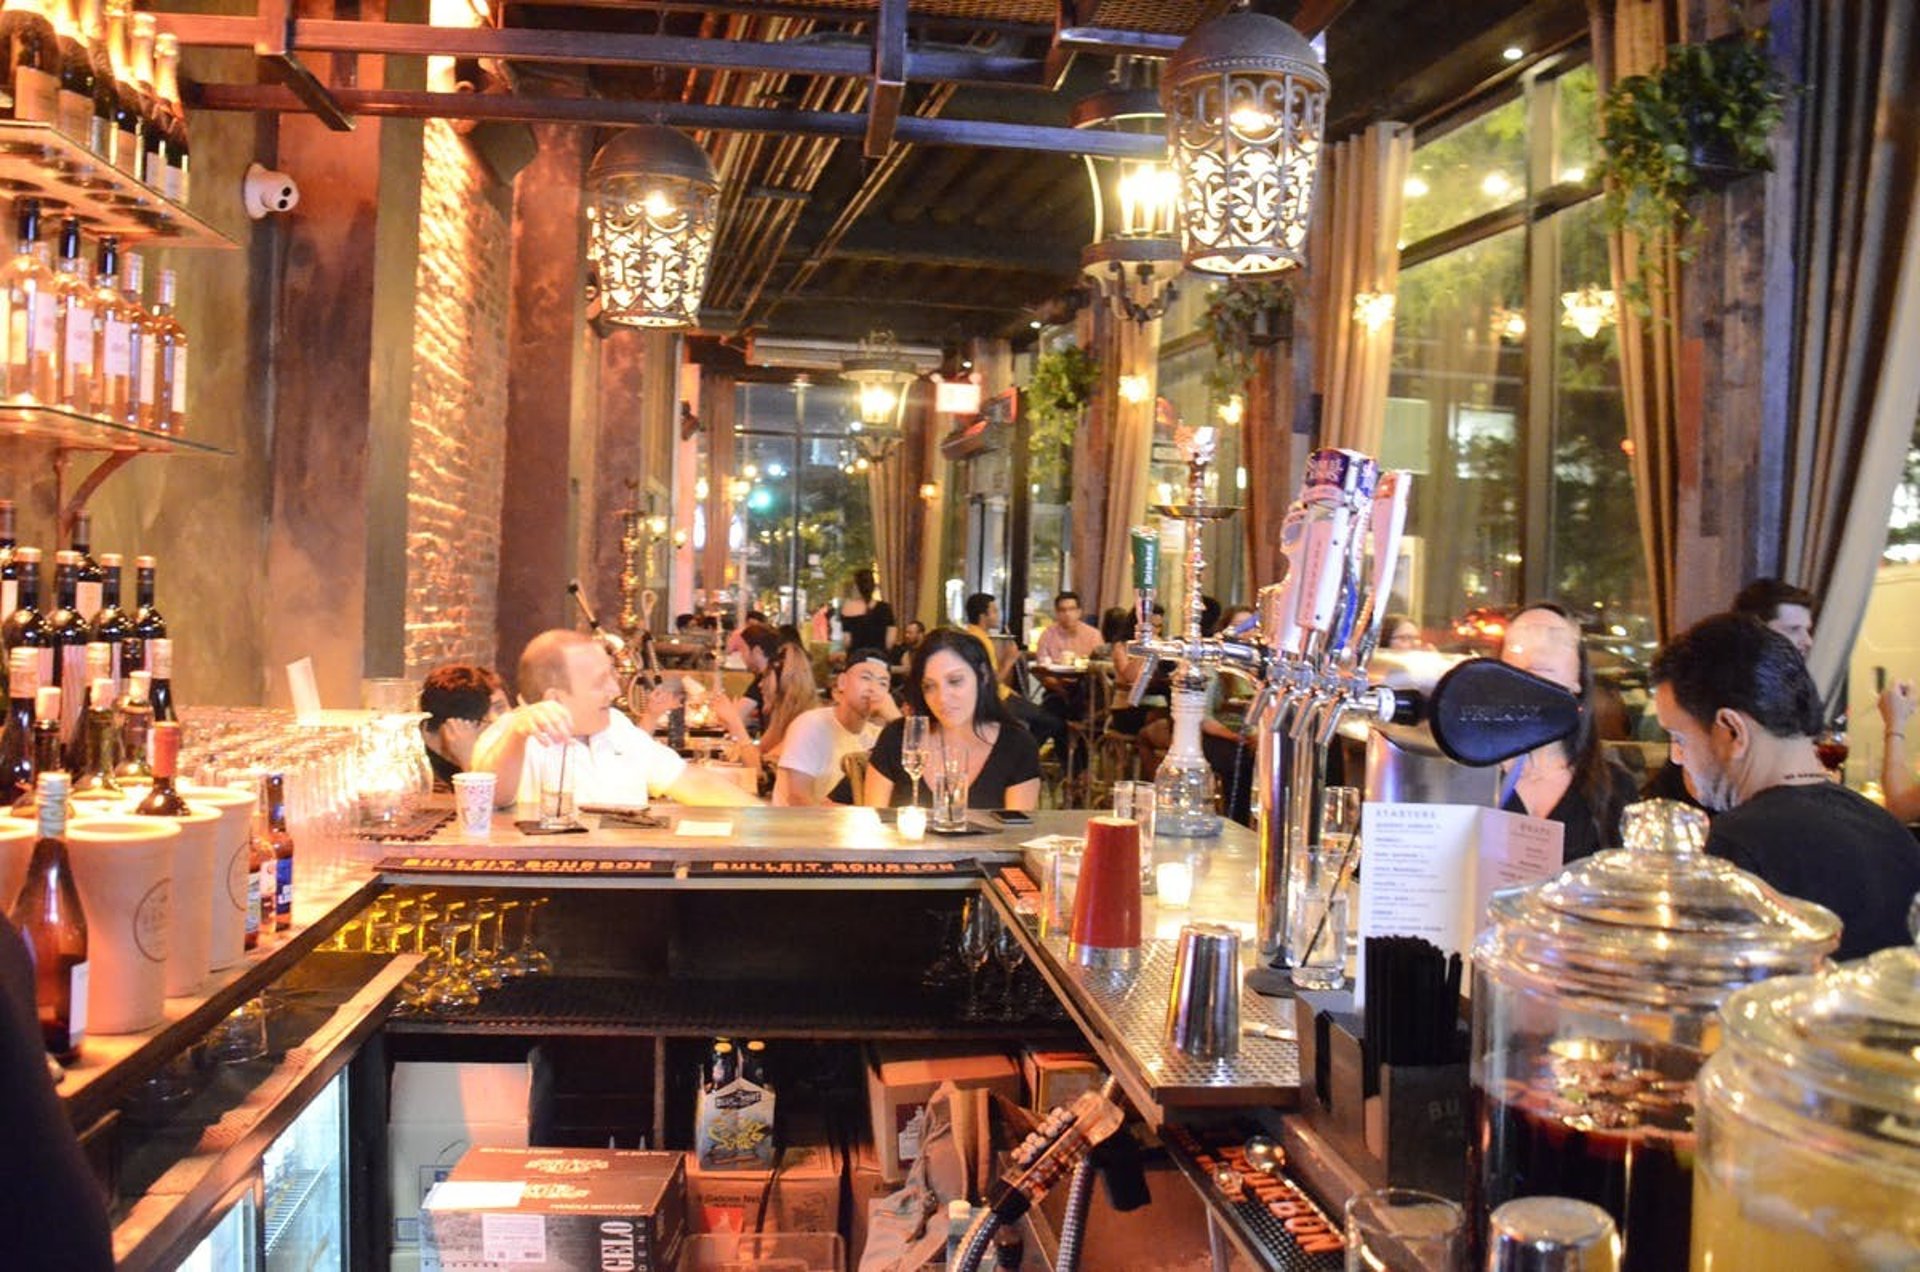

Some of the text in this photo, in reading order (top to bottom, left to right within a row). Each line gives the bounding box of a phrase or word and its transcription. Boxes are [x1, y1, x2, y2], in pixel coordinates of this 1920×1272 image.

[402, 858, 651, 870] BULLEIT BOURBON
[712, 862, 956, 872] BULLEIT BOURBON
